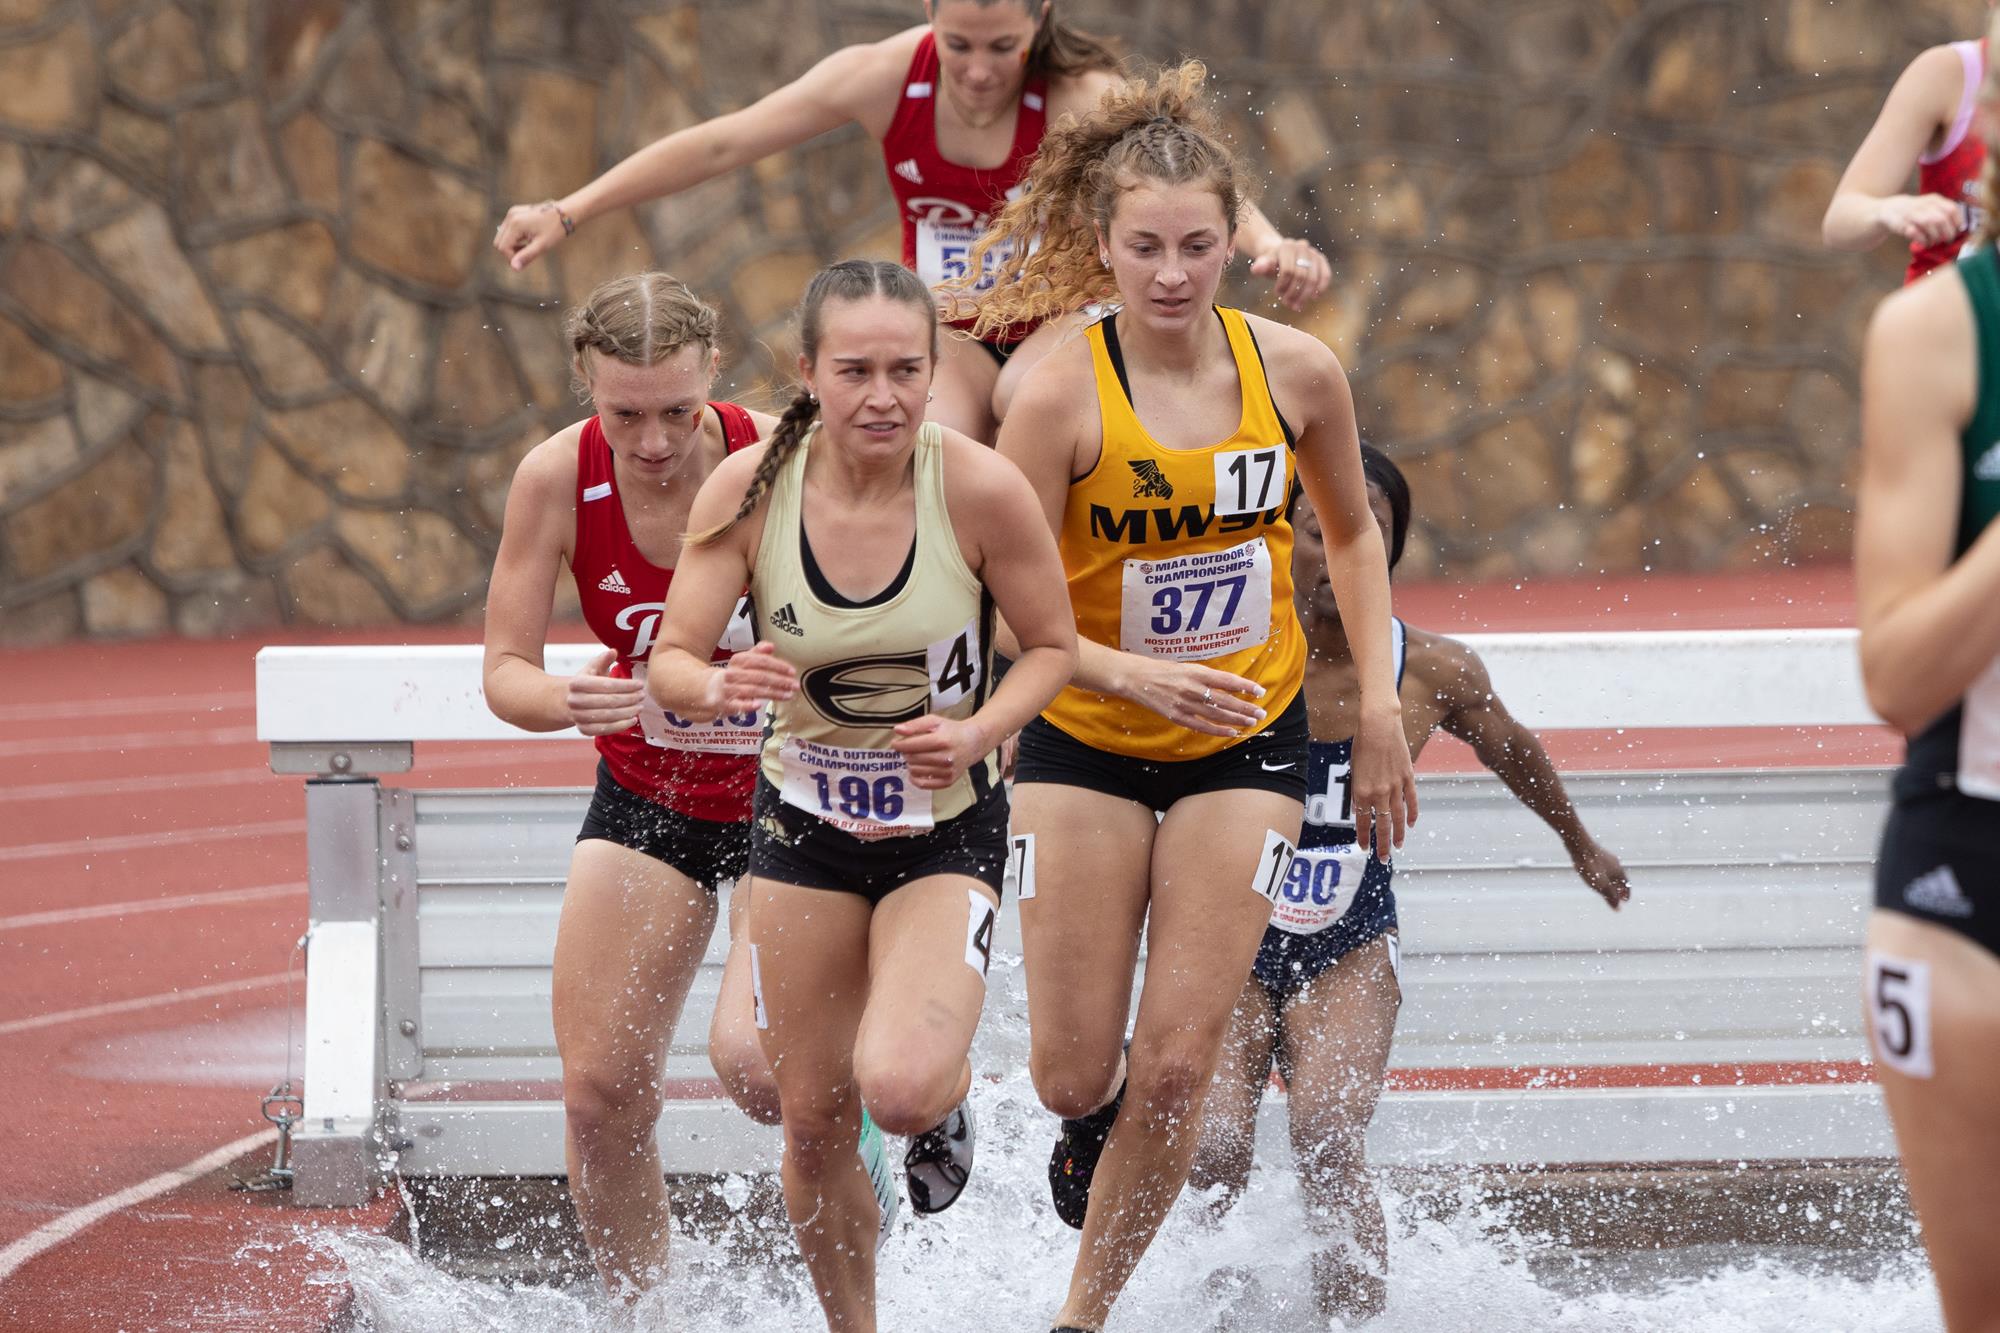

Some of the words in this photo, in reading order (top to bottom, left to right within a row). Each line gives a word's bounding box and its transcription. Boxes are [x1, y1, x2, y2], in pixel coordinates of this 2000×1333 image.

[1228, 450, 1276, 511] 17
[1145, 558, 1254, 585] CHAMPIONSHIPS
[1155, 558, 1187, 572] MIAA
[1191, 548, 1245, 566] OUTDOOR
[598, 582, 631, 595] adidas
[1150, 574, 1247, 635] 377
[769, 615, 804, 637] adidas
[1144, 637, 1182, 647] HOSTED
[1183, 636, 1197, 644] BY
[1199, 626, 1250, 643] PITTSBURG
[1152, 646, 1184, 654] STATE
[1186, 636, 1242, 653] UNIVERSITY
[937, 631, 975, 695] 4
[663, 728, 697, 738] HOSTED
[672, 737, 700, 745] STATE
[703, 738, 758, 746] UNIVERSITY
[808, 743, 839, 758] MIAA
[843, 750, 901, 760] OUTDOOR
[809, 771, 904, 822] 196
[841, 820, 854, 829] BY
[1283, 856, 1341, 906] 90
[1877, 966, 1912, 1058] 5
